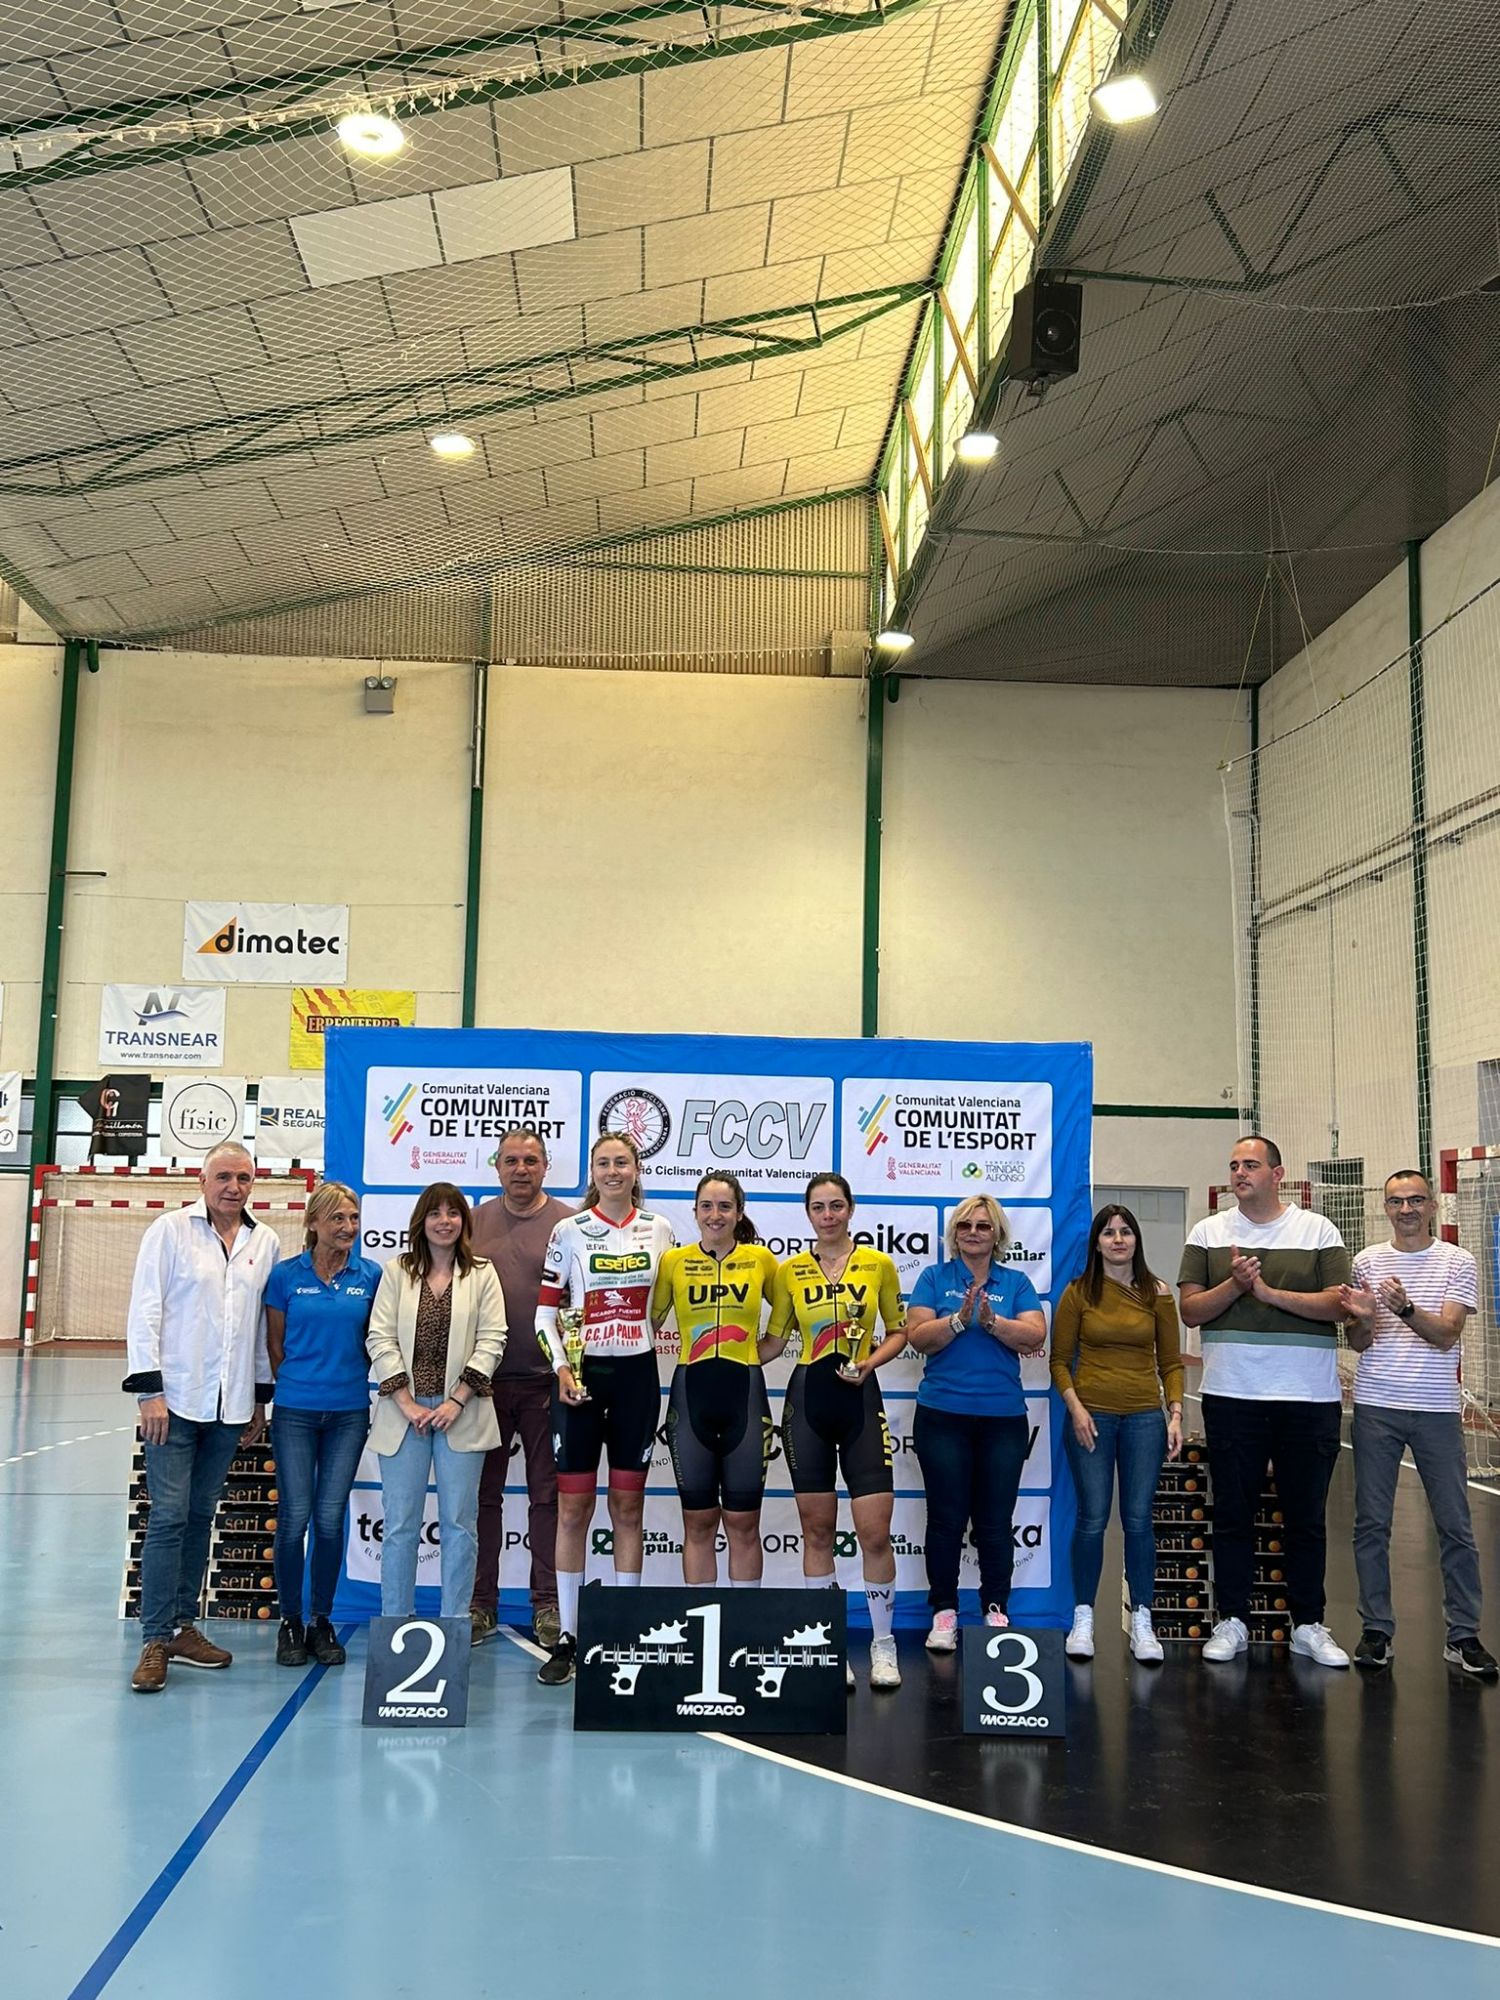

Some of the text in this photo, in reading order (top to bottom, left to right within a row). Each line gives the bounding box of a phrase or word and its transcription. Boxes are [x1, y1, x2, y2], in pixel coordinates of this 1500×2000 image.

[215, 925, 340, 955] dimatec
[105, 1030, 218, 1047] TRANSNEAR
[120, 1051, 202, 1060] www.transnear.com
[422, 1082, 550, 1096] Comunitat Valenciana
[421, 1098, 550, 1118] COMUNITAT
[895, 1094, 1021, 1108] Comunitat Valenciana
[179, 1108, 227, 1131] físic
[283, 1108, 325, 1119] REAL
[894, 1109, 1021, 1130] COMUNITAT
[429, 1119, 458, 1137] DE
[676, 1099, 827, 1160] FCCV
[904, 1131, 1037, 1151] DE L'ESPORT
[656, 1166, 703, 1177] Ciclisme
[765, 1168, 822, 1180] Valencian
[985, 1165, 1025, 1173] TRINIDAD
[985, 1173, 1025, 1182] ALFONSO
[849, 1223, 929, 1255] eika
[594, 1255, 647, 1271] ESETEC
[1001, 1250, 1046, 1263] pular
[688, 1283, 750, 1305] UPV
[804, 1283, 867, 1305] UPV
[988, 1293, 1004, 1302] CCV
[603, 1324, 615, 1339] LA
[616, 1323, 643, 1340] PALMA
[229, 1457, 257, 1473] eri
[227, 1486, 261, 1501] seri
[224, 1515, 259, 1531] seri
[222, 1544, 256, 1560] seri
[1154, 1563, 1179, 1579] eri
[220, 1573, 254, 1589] seri
[1153, 1593, 1180, 1609] eri
[217, 1603, 251, 1619] seri
[684, 1604, 737, 1703] 1
[385, 1621, 447, 1703] 2
[982, 1632, 1043, 1713] 3
[378, 1707, 449, 1719] MOZACO
[677, 1705, 745, 1716] MOZACO
[980, 1714, 1049, 1727] MOZACO
